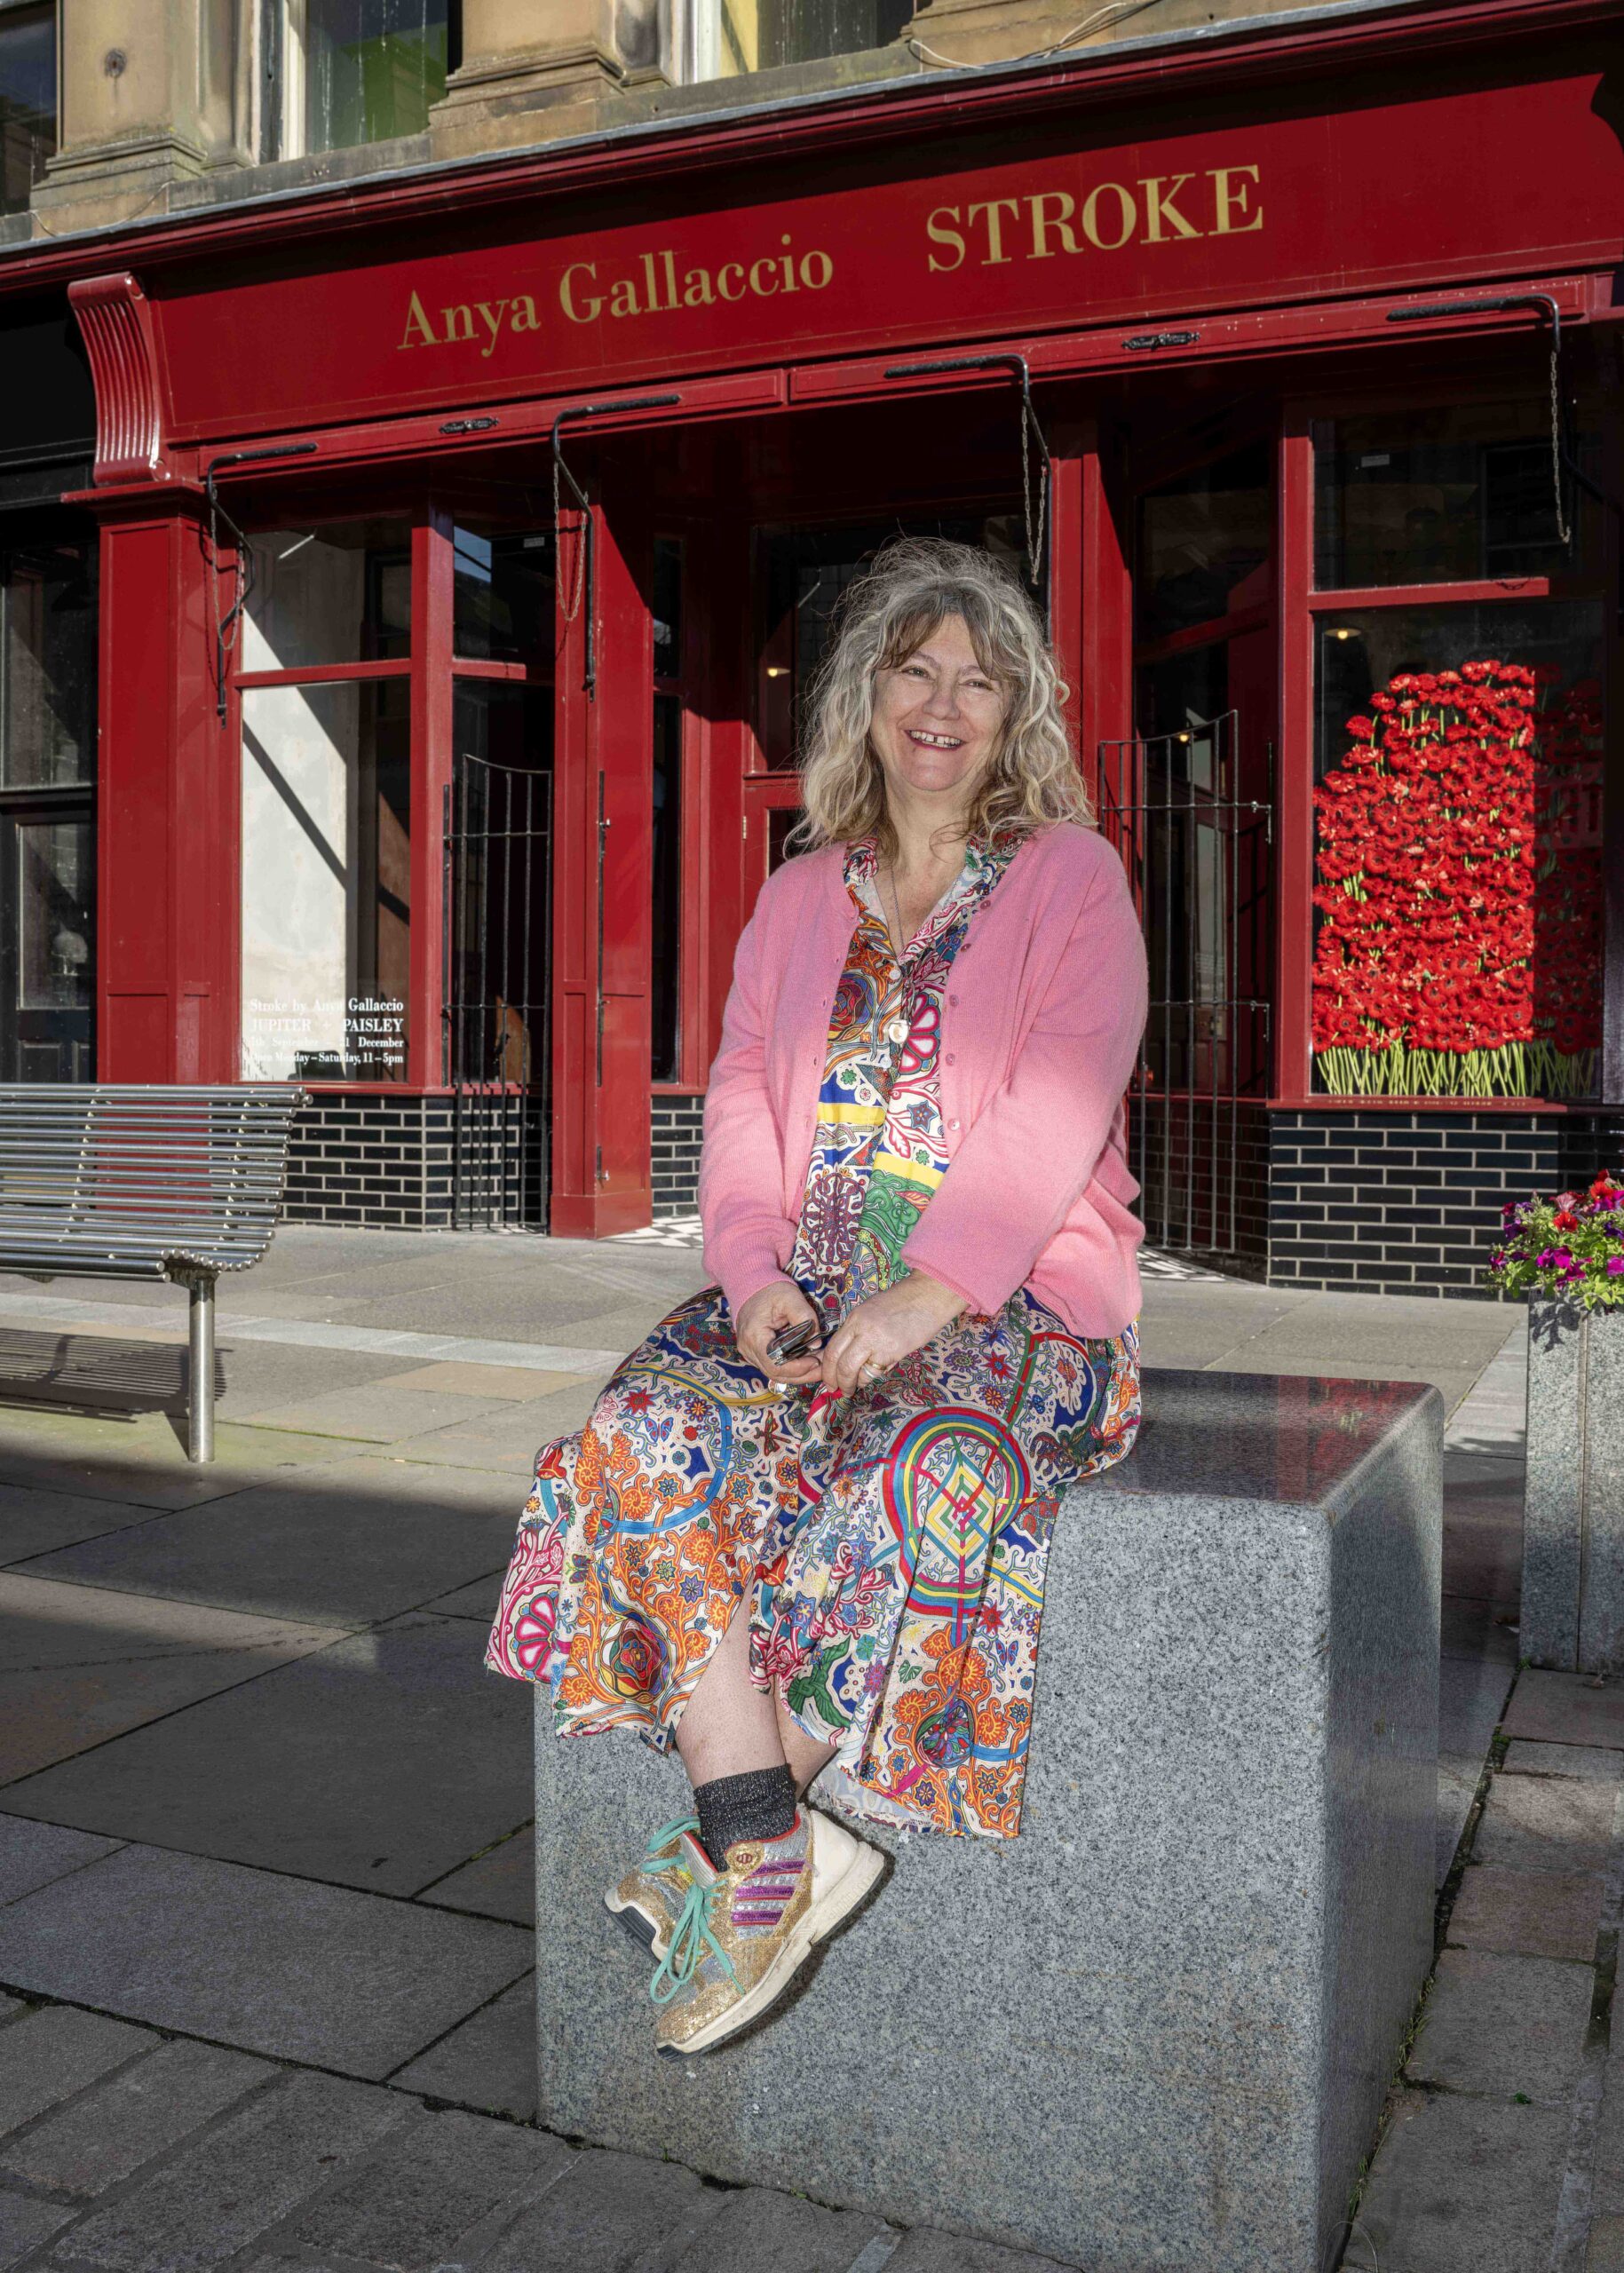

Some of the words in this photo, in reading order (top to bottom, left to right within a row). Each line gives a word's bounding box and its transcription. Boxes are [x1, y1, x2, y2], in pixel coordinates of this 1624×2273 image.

[397, 289, 540, 358] Anya
[558, 234, 833, 323] Gallaccio
[926, 163, 1264, 274] STROKE
[250, 998, 288, 1012] Stroke
[292, 998, 307, 1015] by
[348, 997, 404, 1012] Gallaccio
[251, 1018, 312, 1032] JUPITER
[342, 1018, 404, 1033] PAISLEY
[358, 1036, 404, 1048] December
